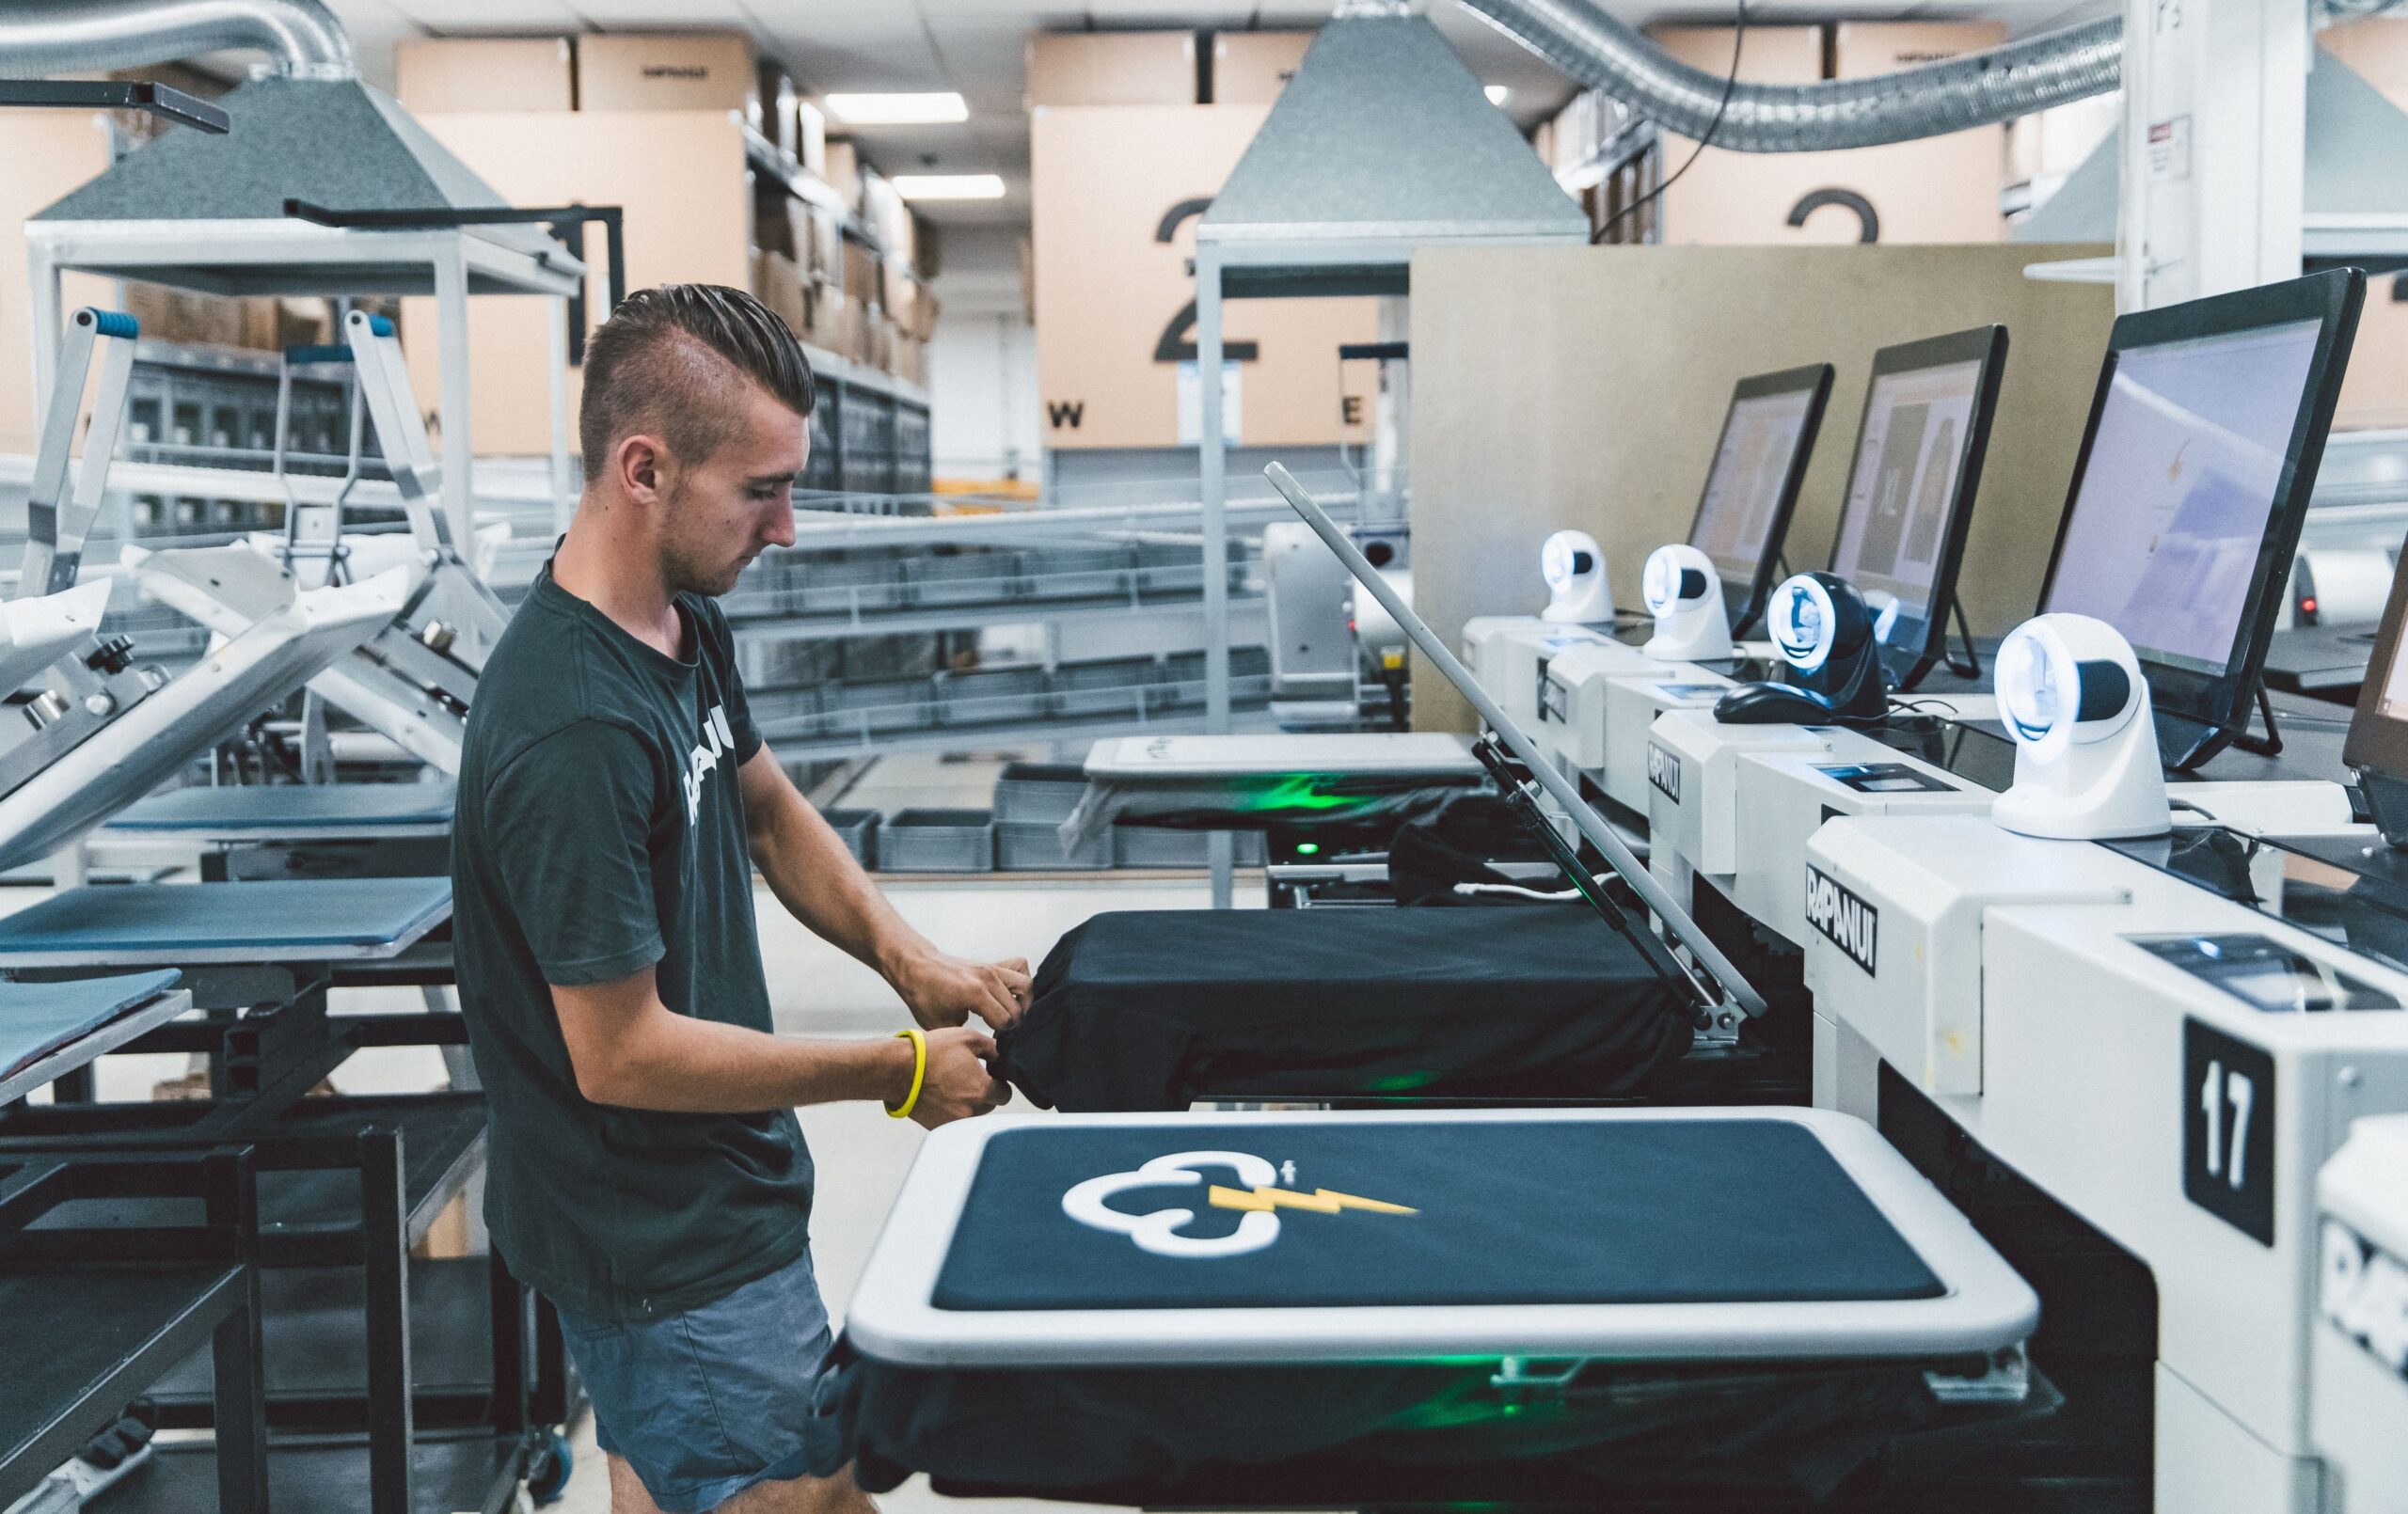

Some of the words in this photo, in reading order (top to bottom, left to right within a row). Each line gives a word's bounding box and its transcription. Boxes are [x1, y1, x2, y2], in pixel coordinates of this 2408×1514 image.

[1048, 402, 1084, 428] W
[1341, 396, 1363, 425] E
[1806, 865, 1874, 969] RAPANUI
[2202, 1059, 2254, 1190] 17
